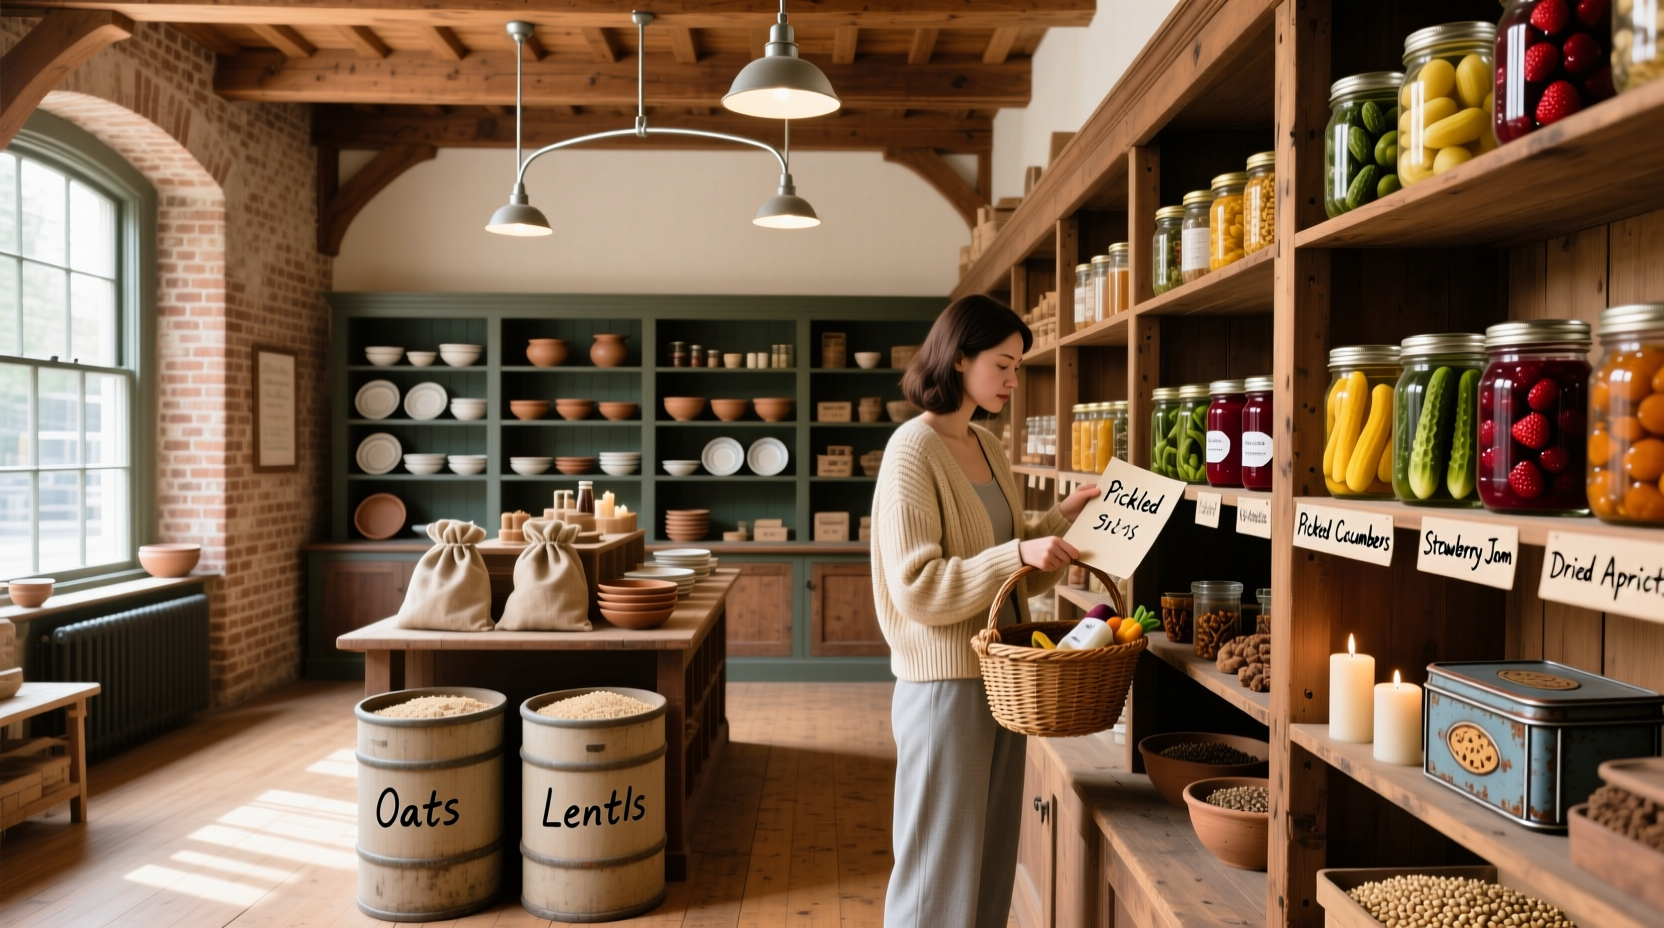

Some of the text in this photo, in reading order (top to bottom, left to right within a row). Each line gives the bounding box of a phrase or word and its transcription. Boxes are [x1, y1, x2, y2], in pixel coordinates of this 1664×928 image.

[1103, 480, 1165, 514] Pickled
[1484, 537, 1512, 565] Jam
[1550, 551, 1664, 601] Dried Aprict
[376, 787, 460, 828] Oats
[542, 785, 646, 828] Lentls
